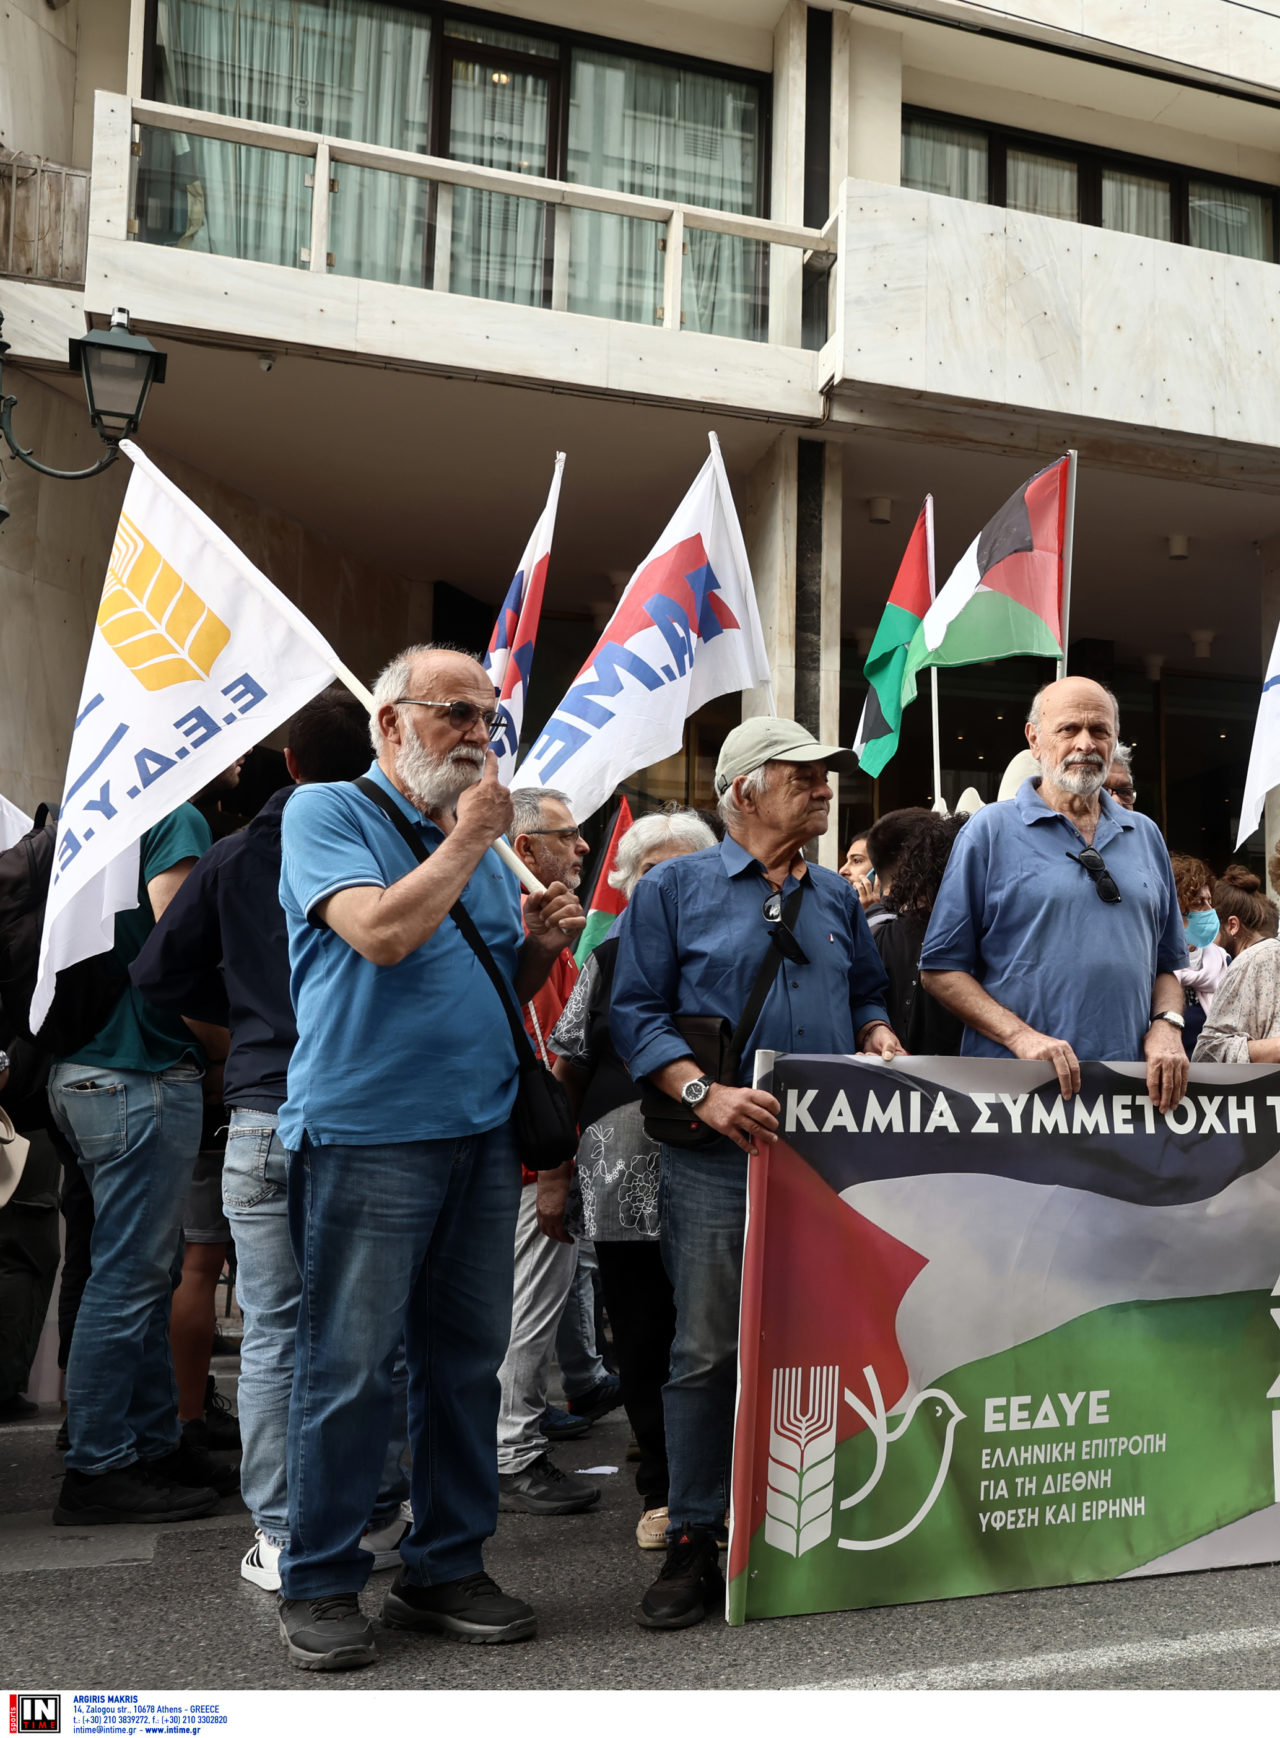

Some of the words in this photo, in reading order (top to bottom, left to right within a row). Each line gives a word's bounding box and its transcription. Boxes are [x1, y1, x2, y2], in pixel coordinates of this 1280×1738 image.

[784, 1089, 960, 1134] ΚΑΜΙΑ
[969, 1092, 1257, 1135] ΣΥΜΜΕΤΟΧΗ
[984, 1389, 1110, 1433] ΕΕΔΥΕ
[981, 1441, 1076, 1469] ΕΛΛΗΝΙΚΗ
[1081, 1433, 1167, 1460] ΕΠΙΤΡΟΠΗ
[980, 1479, 1009, 1501] ΓΙΑ
[1015, 1476, 1037, 1498] ΤΗ
[1042, 1468, 1112, 1494] ΔΙΕΘΝΗ
[979, 1506, 1039, 1533] ΥΦΕΣΗ
[1045, 1503, 1076, 1525] ΚΑΙ
[1082, 1496, 1146, 1521] ΕΙΡΗΝΗ
